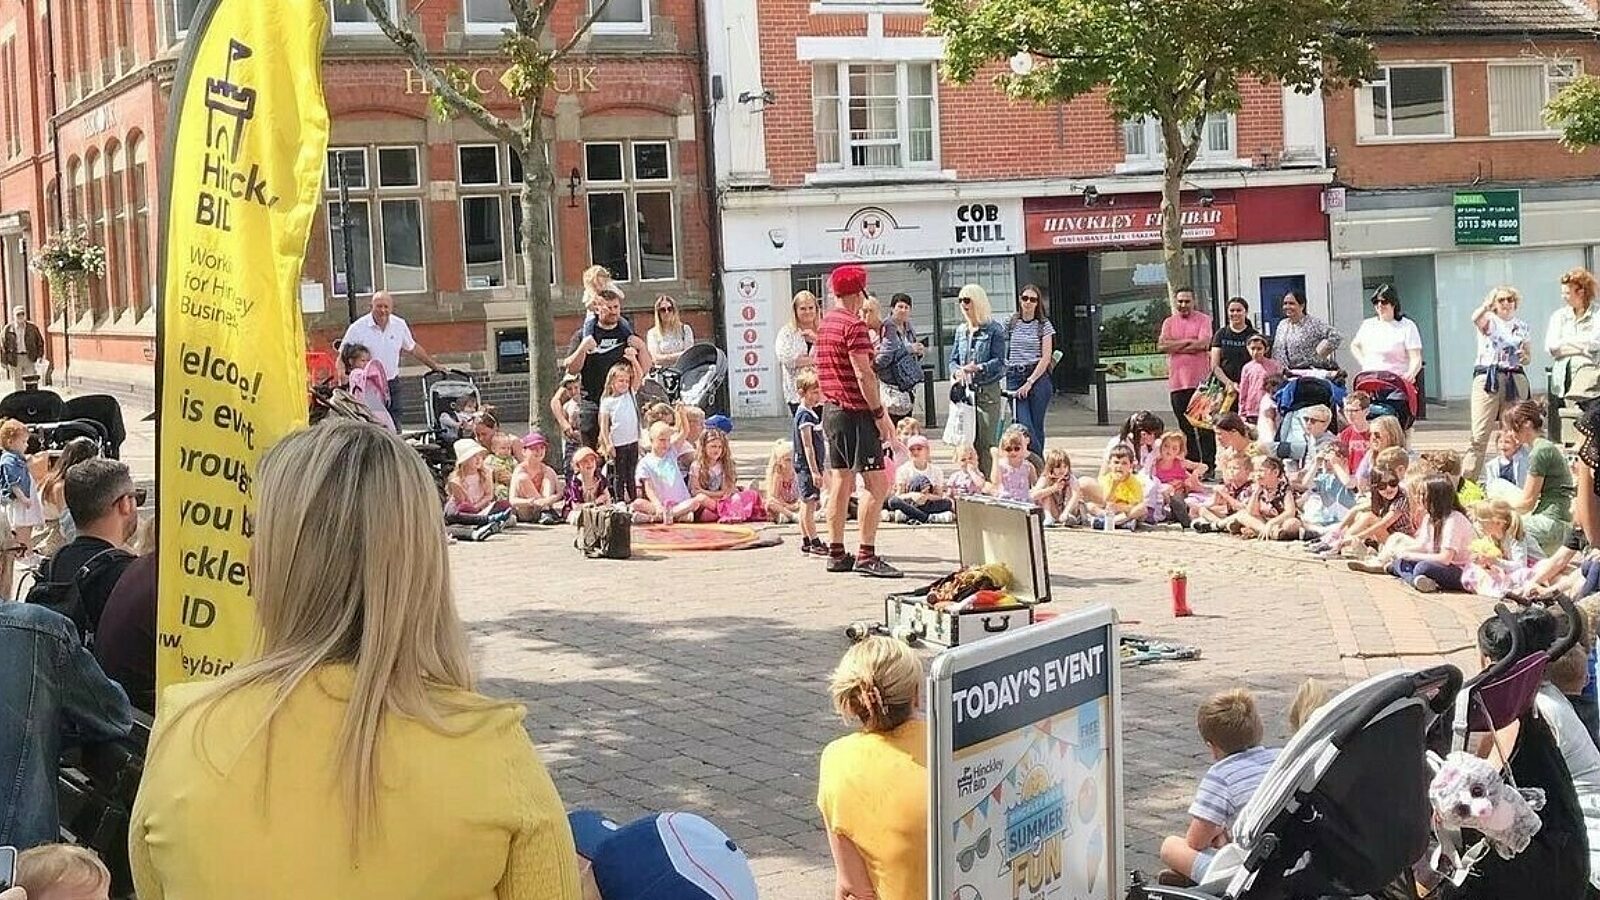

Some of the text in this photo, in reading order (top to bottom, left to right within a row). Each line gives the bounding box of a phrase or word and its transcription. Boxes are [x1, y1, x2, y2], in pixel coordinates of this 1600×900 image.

[404, 66, 600, 94] HBC UK
[957, 204, 998, 222] COB
[1043, 210, 1221, 232] HINCKLEY FIBAR
[1457, 220, 1479, 228] 0113
[955, 224, 1005, 242] FULL
[180, 343, 262, 404] elcoe!
[180, 545, 253, 596] ckle
[181, 595, 216, 629] ID
[953, 645, 1104, 723] TODAY'S EVENT
[973, 758, 1004, 779] Hinckley
[974, 777, 988, 791] BID
[1009, 806, 1063, 853] SUMMER
[1012, 835, 1062, 900] FUN
